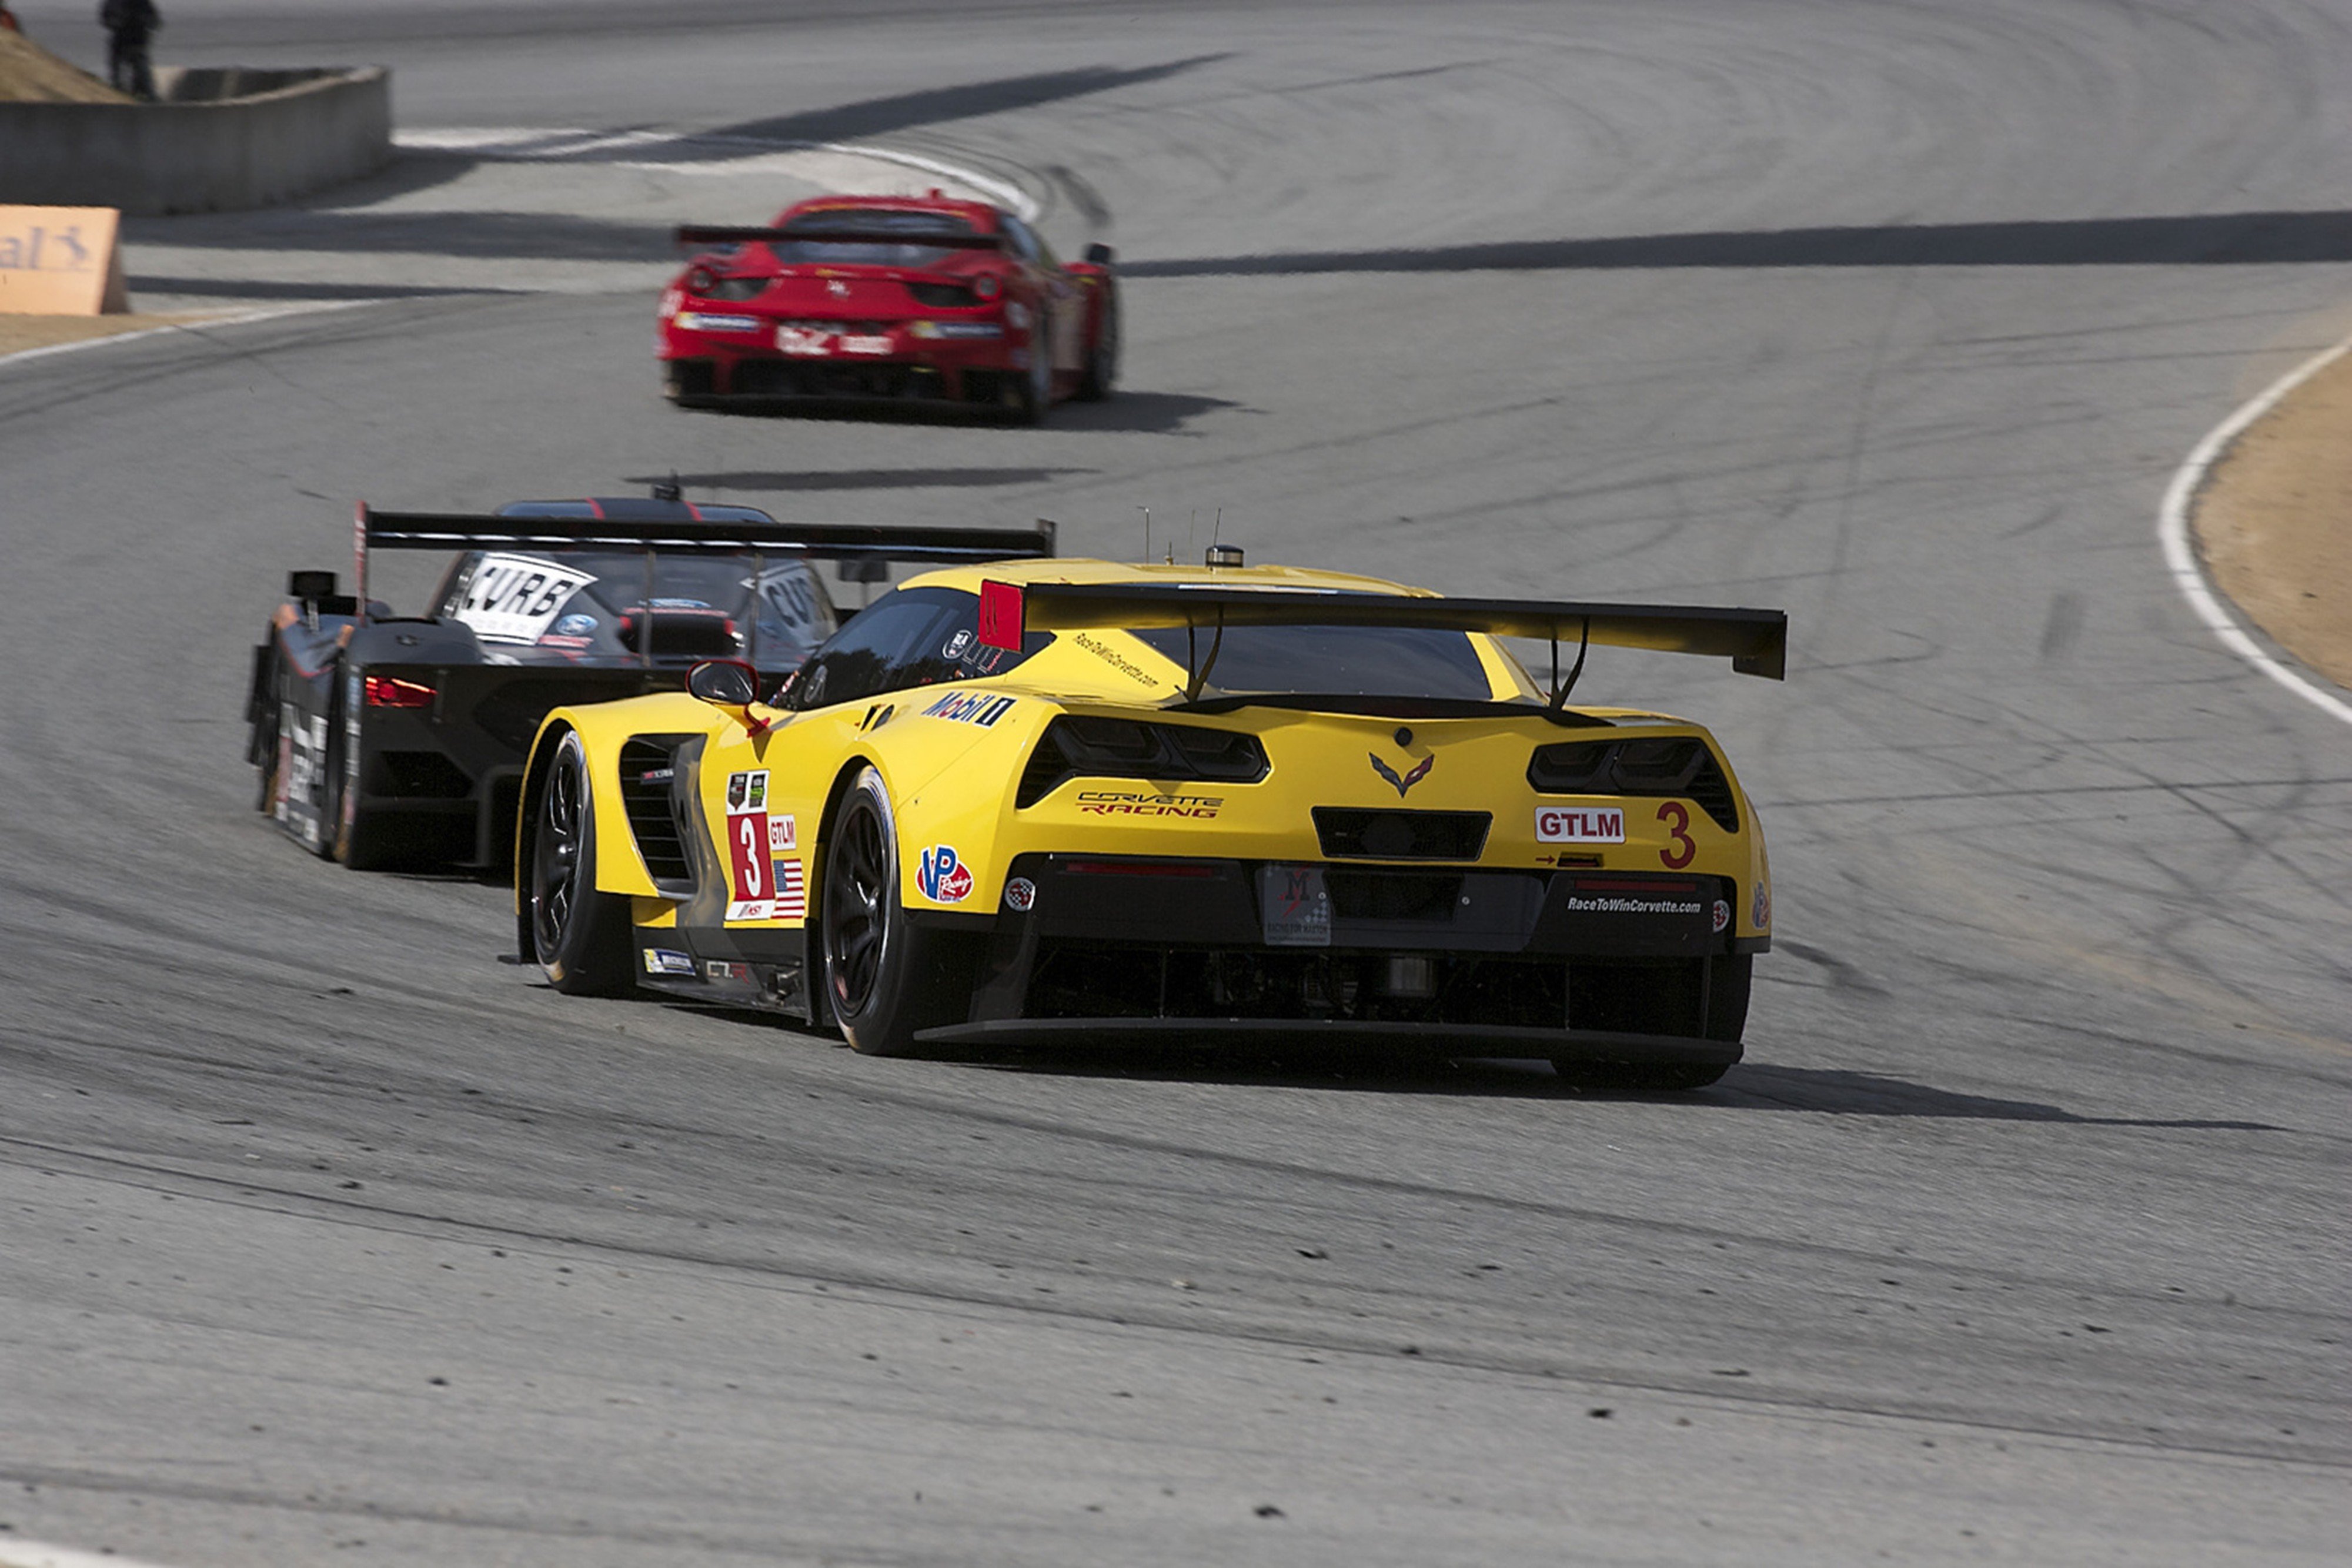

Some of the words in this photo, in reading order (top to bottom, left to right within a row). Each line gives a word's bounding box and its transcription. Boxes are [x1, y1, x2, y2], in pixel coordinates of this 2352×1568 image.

[921, 691, 996, 723] Mobil
[980, 698, 1011, 726] 1
[1075, 803, 1218, 818] RACING
[1078, 792, 1224, 807] CORVETTE
[770, 820, 796, 844] GTLM
[1539, 813, 1622, 837] GTLM
[1656, 801, 1696, 870] 3
[740, 817, 762, 897] 3
[923, 847, 956, 900] VP
[1285, 871, 1311, 901] M
[1567, 897, 1701, 913] RaceToWinCorvette.com
